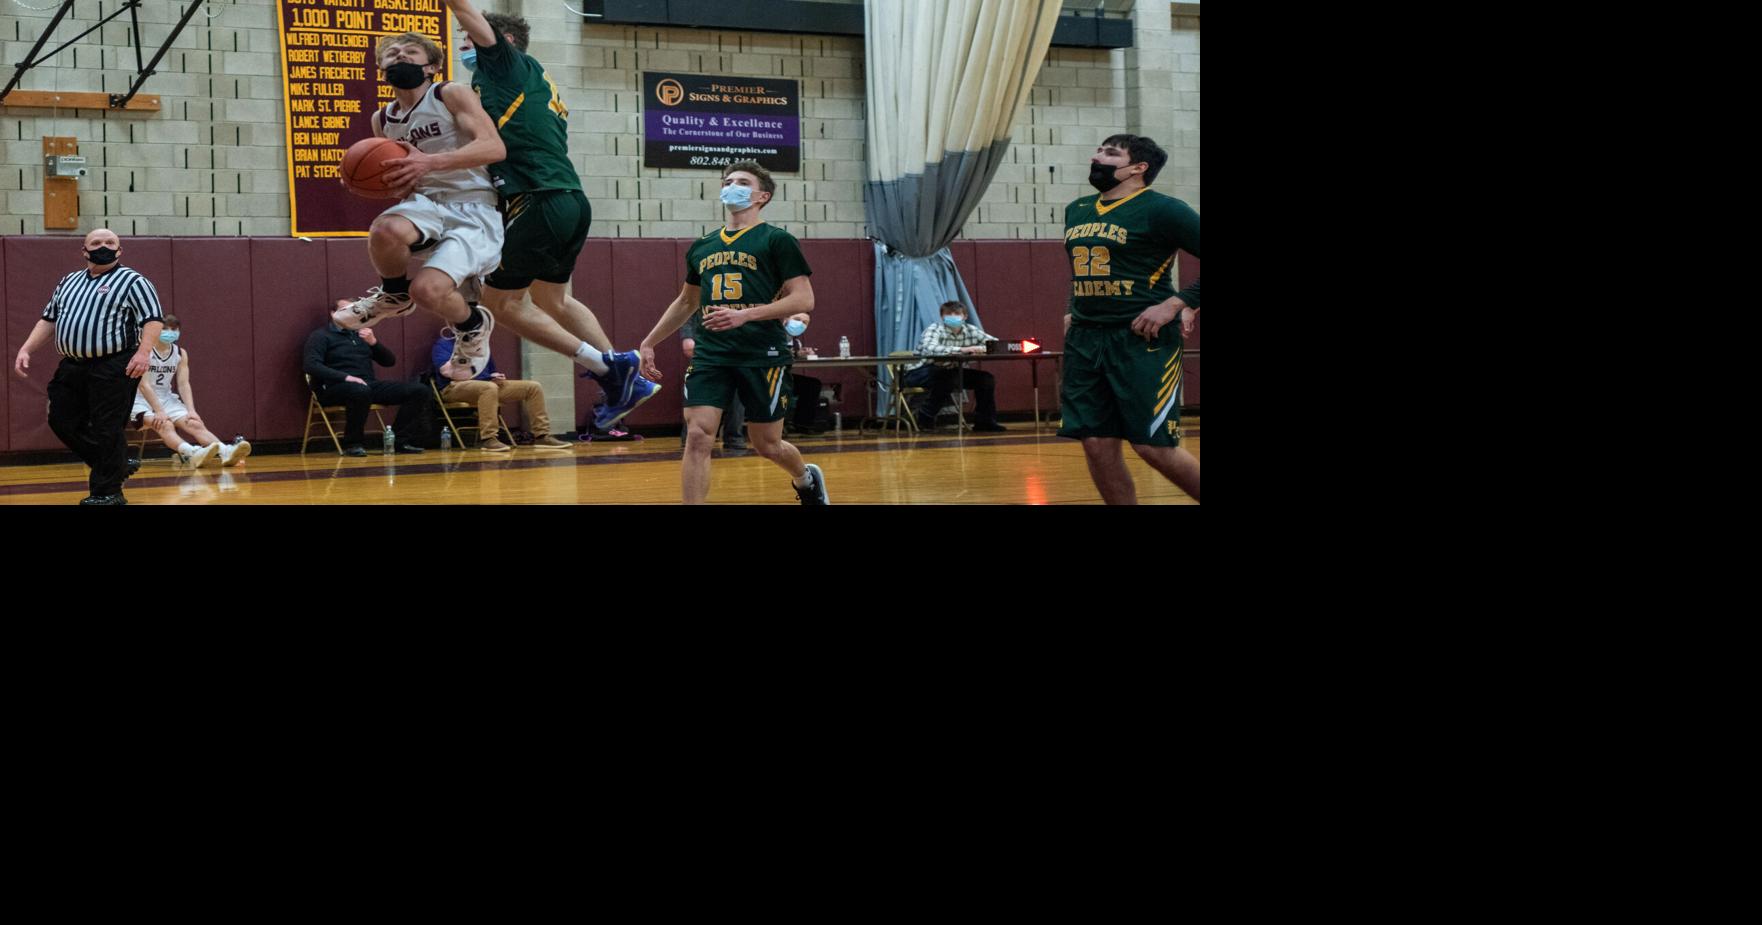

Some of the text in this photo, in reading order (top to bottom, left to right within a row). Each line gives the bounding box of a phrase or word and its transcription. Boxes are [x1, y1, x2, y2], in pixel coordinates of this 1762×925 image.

[336, 10, 374, 29] POINT
[382, 13, 439, 34] SCORERS
[286, 32, 320, 46] WILFRED
[322, 34, 369, 48] POLLENDER
[288, 49, 366, 63] ROBERT WETHERBY
[290, 66, 317, 79] JAMES
[320, 67, 366, 80] FRECHETTE
[290, 83, 310, 96] MIKE
[313, 83, 344, 96] FULLER
[711, 84, 766, 95] PREMIER
[291, 99, 361, 112] MARK ST. PIERRE
[689, 92, 788, 106] SIGNS & GRAPHICS
[293, 116, 350, 129] LANCE GIBNEY
[662, 114, 783, 129] Quality & Excellence
[294, 132, 339, 145] BEN HARDY
[662, 127, 784, 140] The Cornerstone of Our Business
[295, 149, 318, 162] BRIAN
[669, 144, 778, 155] premiersignsandgraphics.com
[296, 165, 310, 178] PAT
[1064, 222, 1128, 246] PEOPLES
[699, 251, 757, 275] PEOPLES
[1072, 246, 1111, 276] 22
[711, 272, 743, 300] 15
[156, 373, 165, 386] 2
